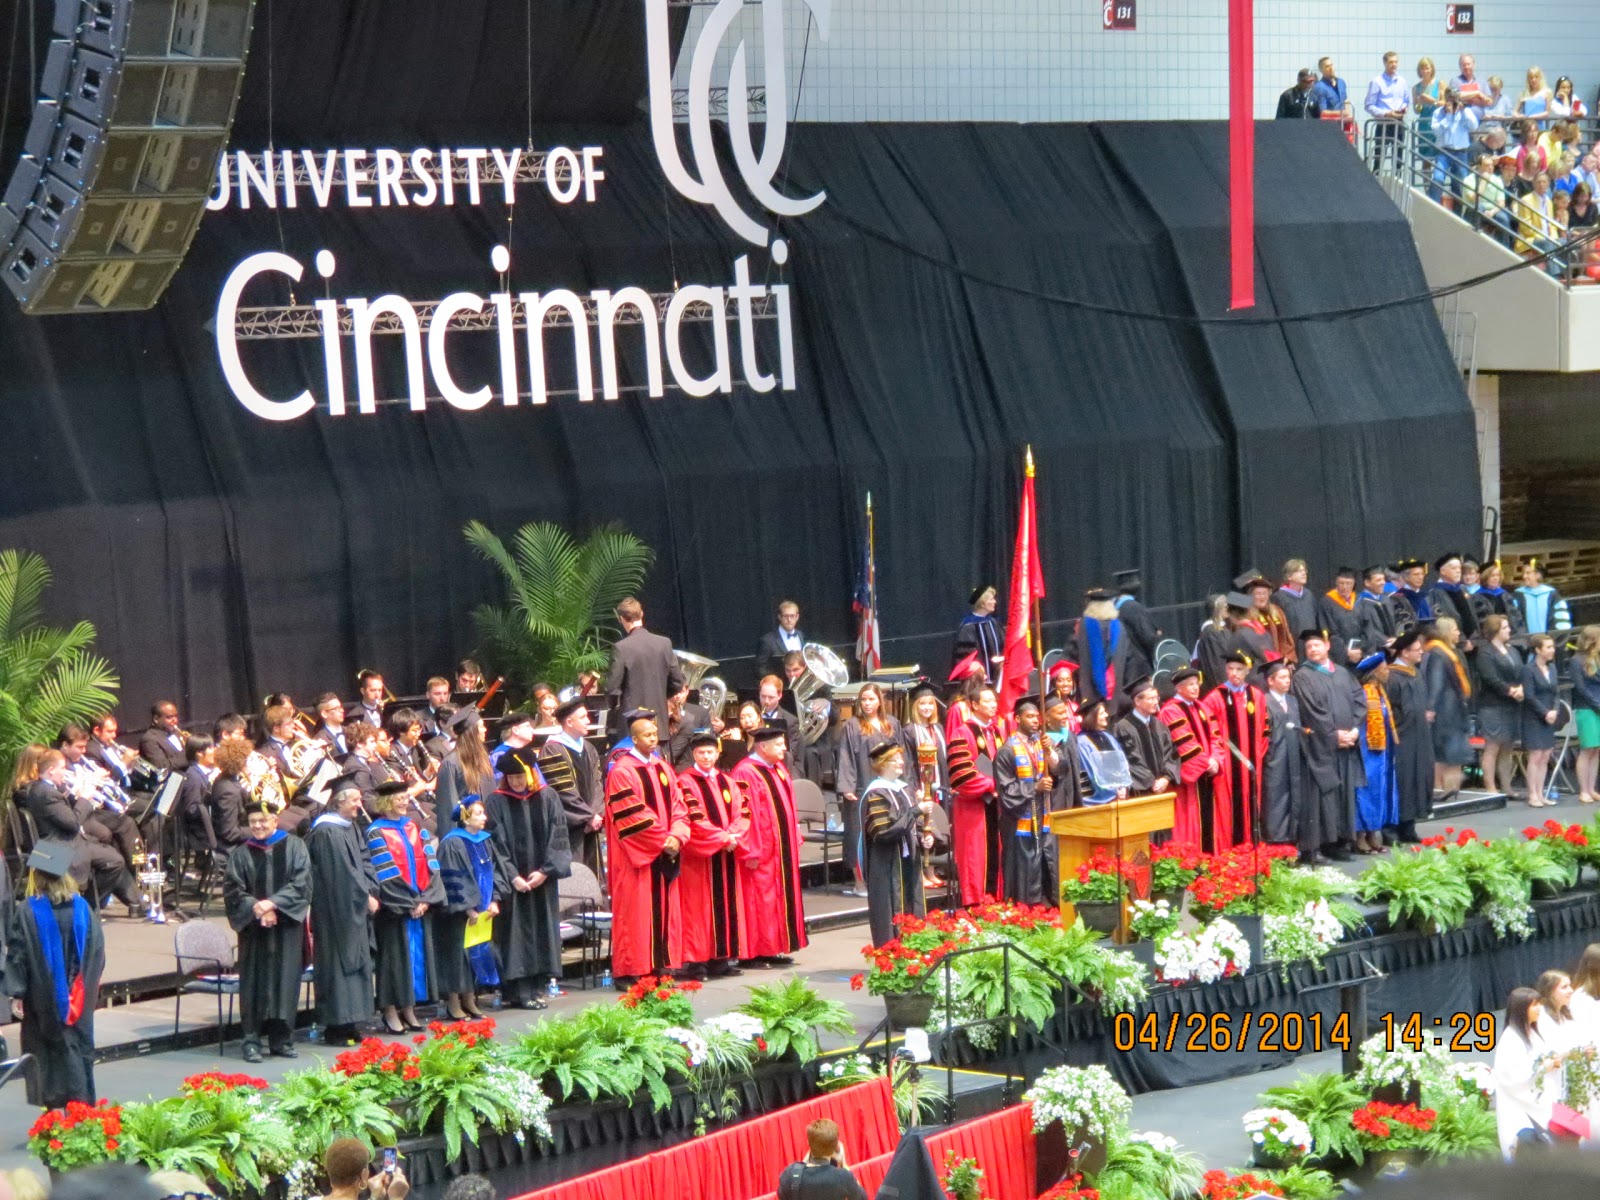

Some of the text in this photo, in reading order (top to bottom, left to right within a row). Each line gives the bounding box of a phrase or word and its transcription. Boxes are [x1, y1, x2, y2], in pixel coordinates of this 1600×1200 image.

[1117, 6, 1131, 19] 131
[1457, 11, 1471, 24] 132
[545, 146, 605, 203] OF
[216, 238, 797, 422] Cincinnati
